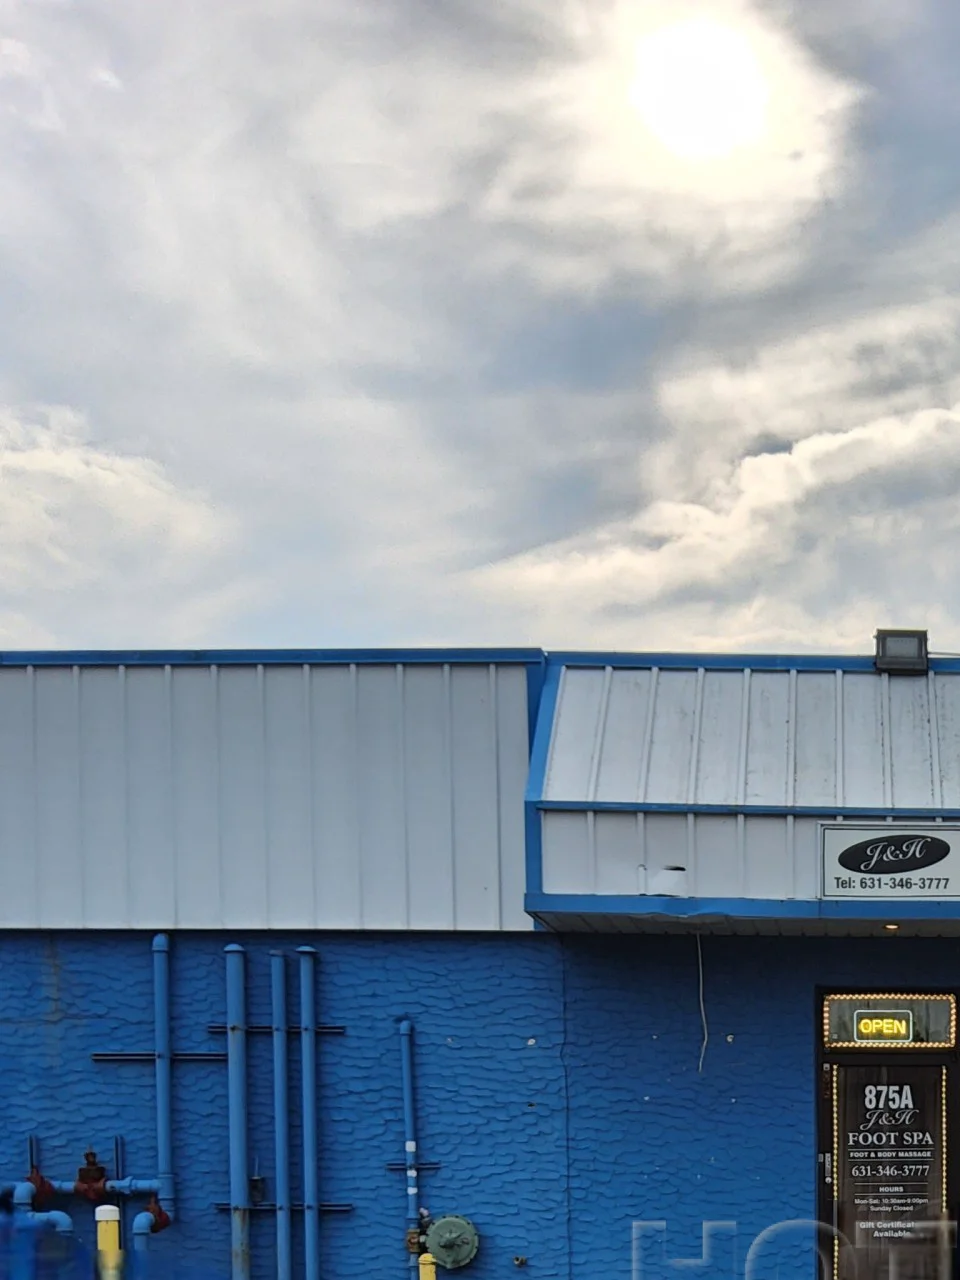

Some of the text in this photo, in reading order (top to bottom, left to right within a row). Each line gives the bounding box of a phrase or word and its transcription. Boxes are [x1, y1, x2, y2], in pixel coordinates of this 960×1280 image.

[860, 838, 932, 871] J&H
[834, 876, 950, 890] Tel: 631-346-3777
[859, 1018, 907, 1034] OPEN
[864, 1085, 914, 1109] 875A
[859, 1109, 919, 1131] J&H
[848, 1131, 934, 1146] FOOT SPA
[851, 1165, 930, 1177] 631-346-3777
[859, 1221, 875, 1229] Gift
